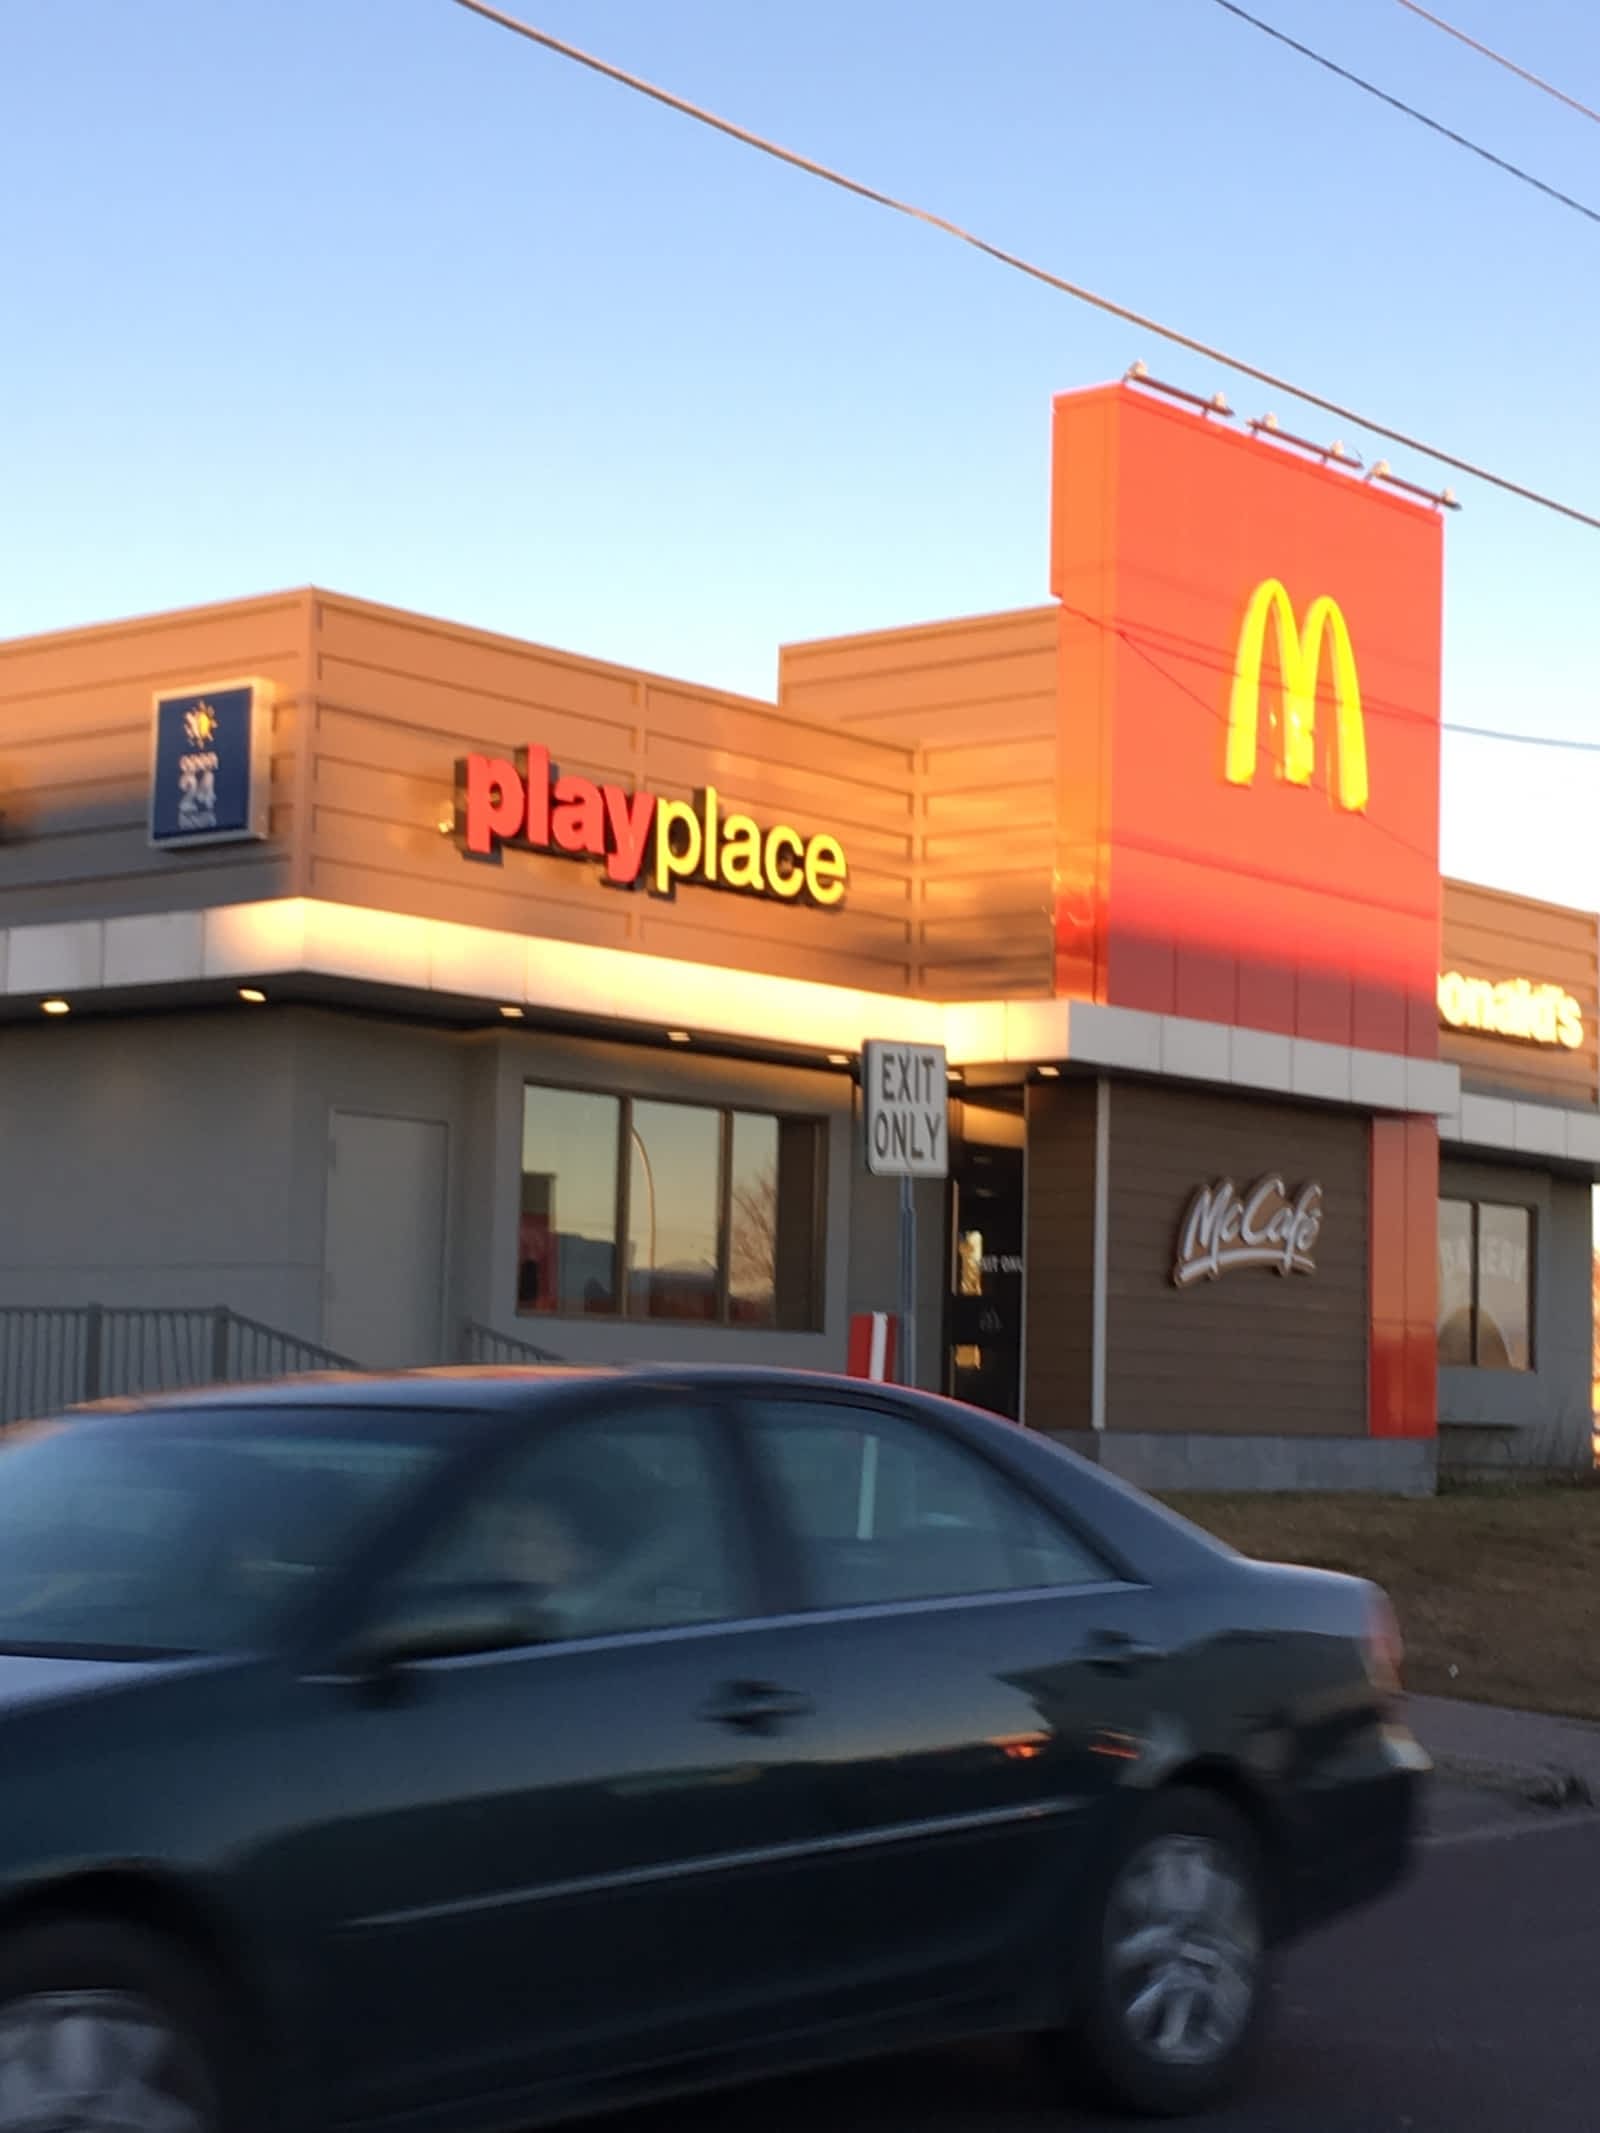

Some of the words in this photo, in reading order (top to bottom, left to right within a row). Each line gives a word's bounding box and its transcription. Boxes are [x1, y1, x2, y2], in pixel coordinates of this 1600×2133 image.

[881, 1053, 936, 1104] EXIT
[874, 1109, 943, 1161] ONLY
[1443, 1235, 1527, 1284] BAERY
